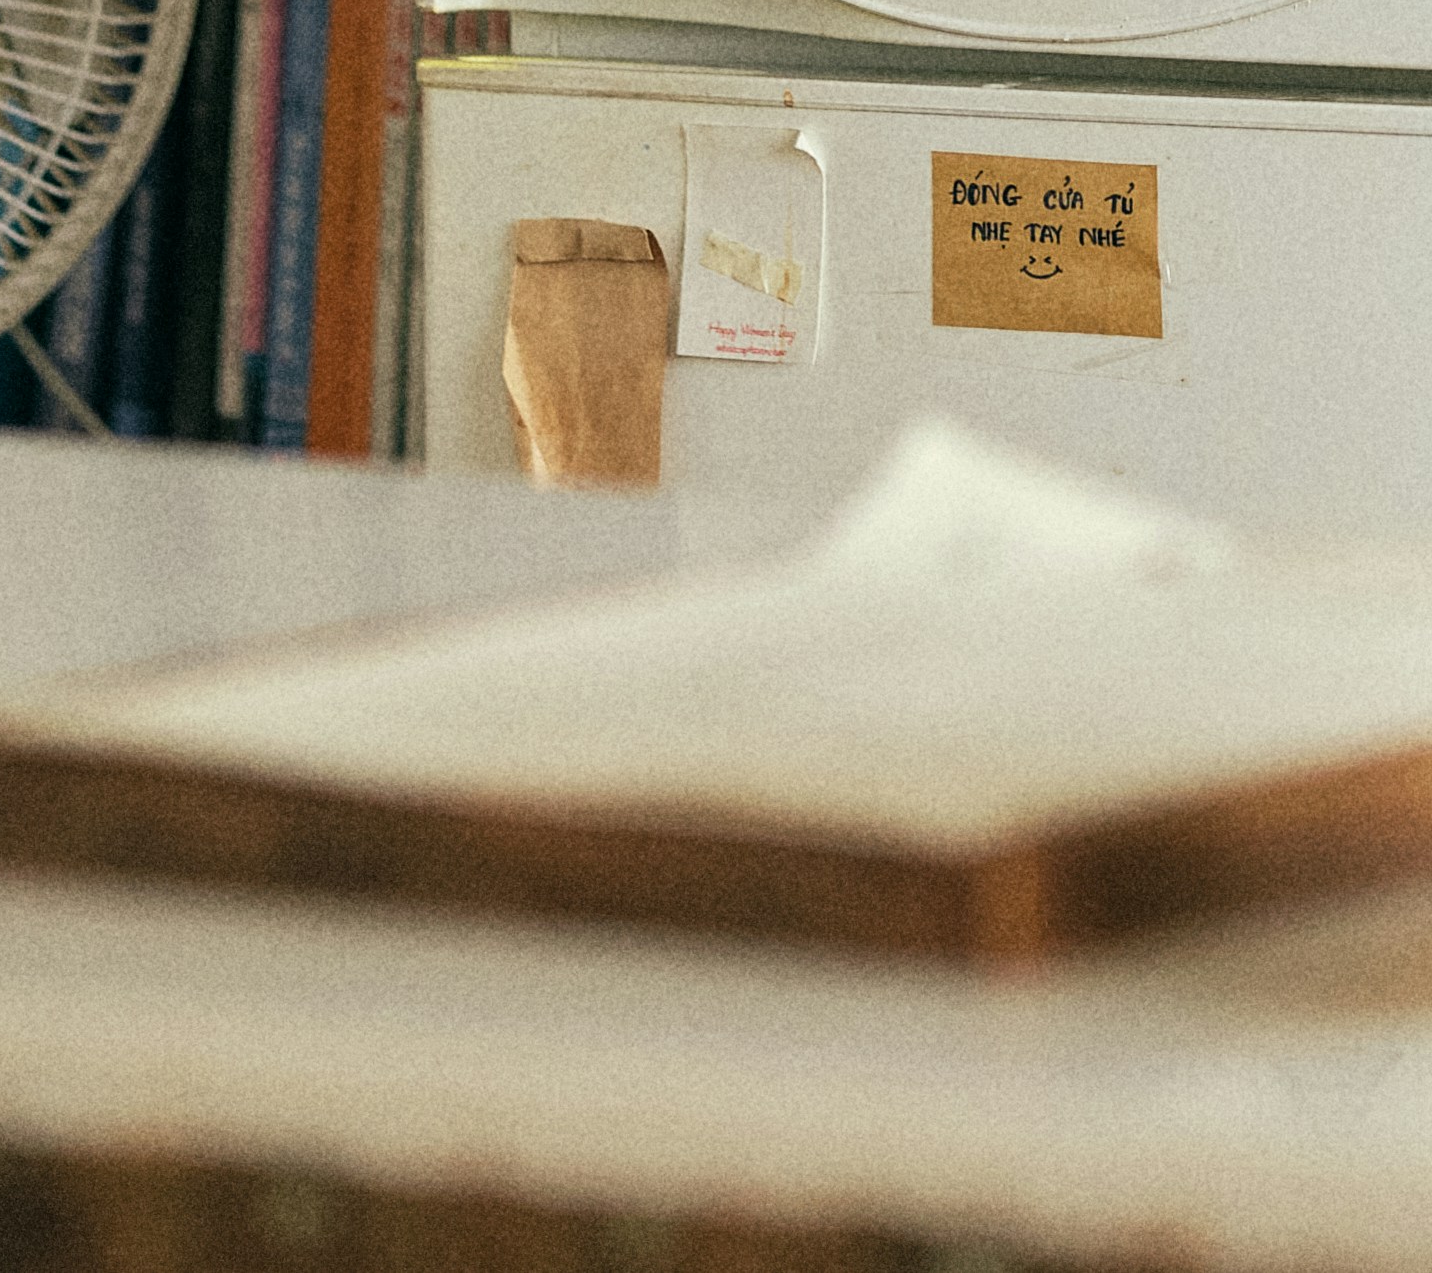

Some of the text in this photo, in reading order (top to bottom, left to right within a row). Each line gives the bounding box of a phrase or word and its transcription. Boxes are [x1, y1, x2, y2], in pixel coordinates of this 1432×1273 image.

[949, 170, 1136, 215] ĐÓNG CỬA TỦ
[971, 221, 1126, 249] NHẸ TAY NHÉ
